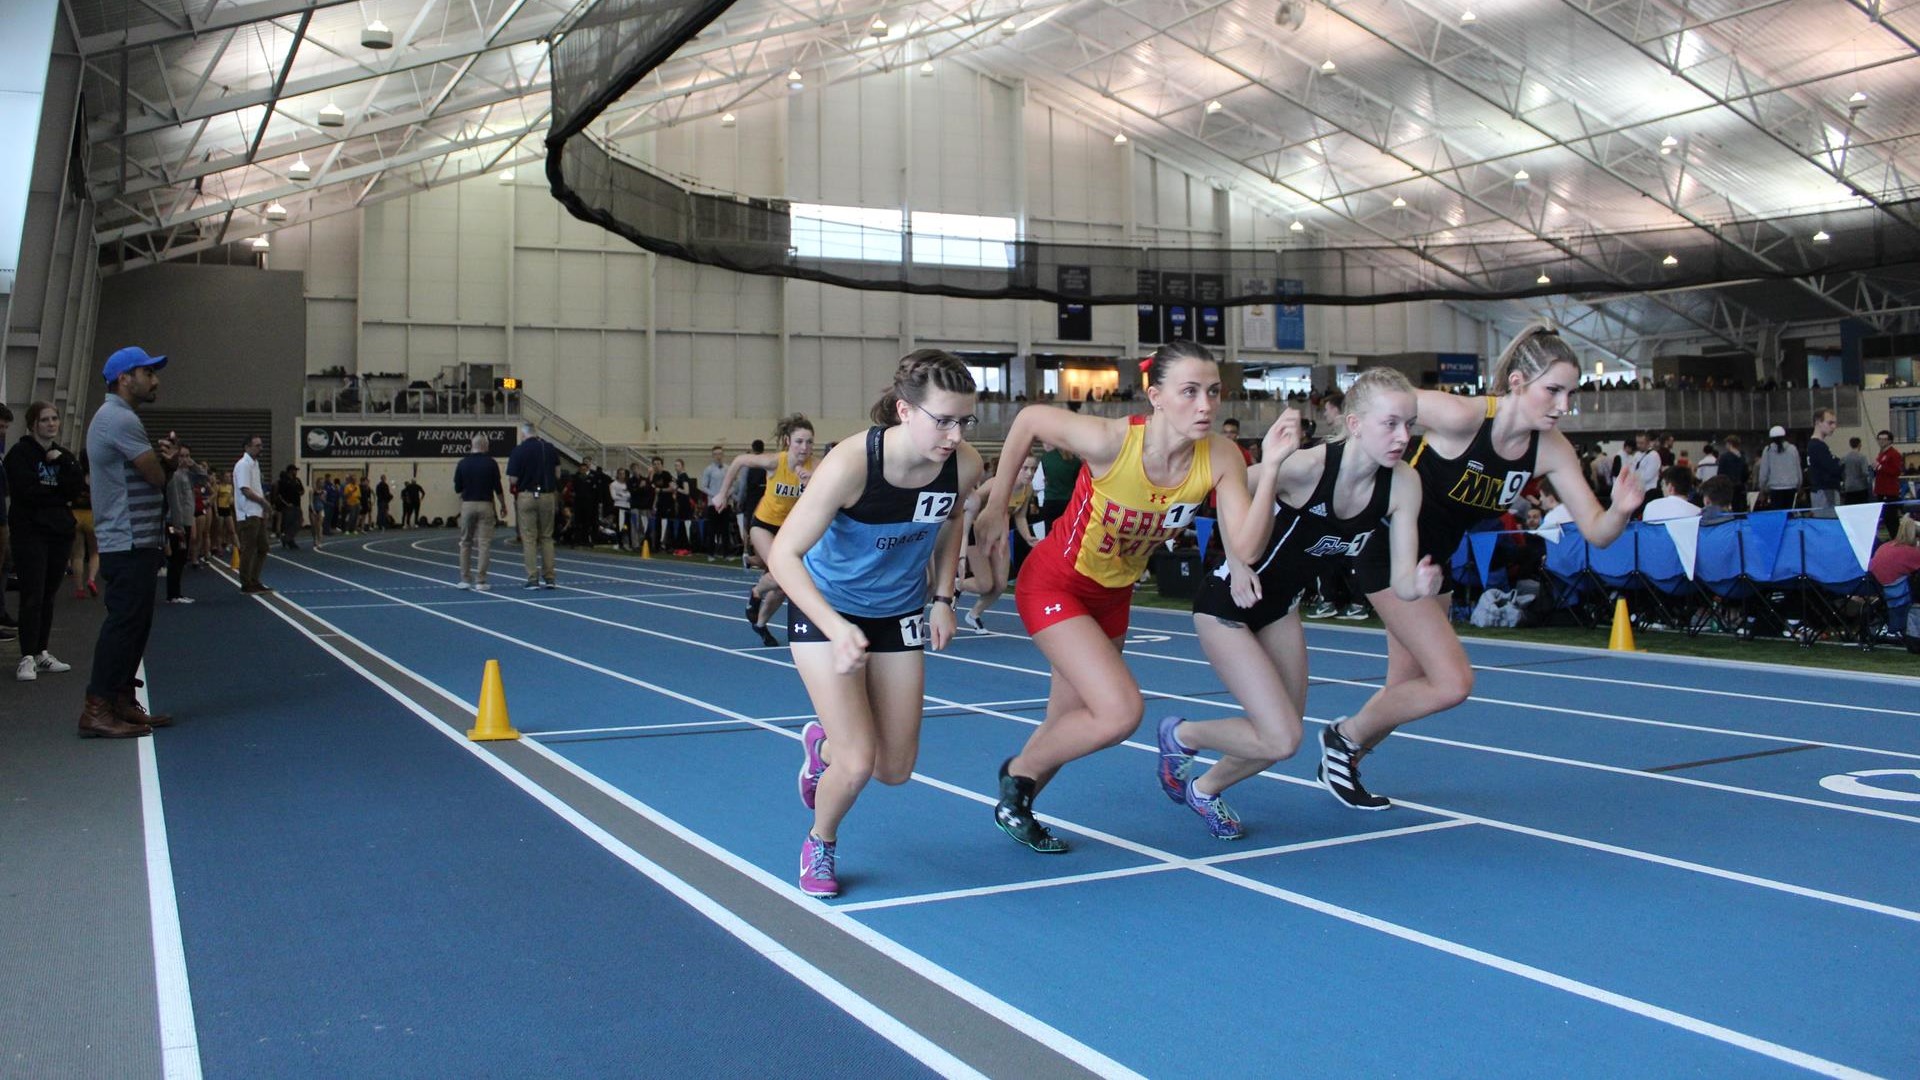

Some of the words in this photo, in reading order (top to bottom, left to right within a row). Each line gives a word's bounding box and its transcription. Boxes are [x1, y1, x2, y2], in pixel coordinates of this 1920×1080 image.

[331, 430, 403, 446] NovaCare
[441, 444, 472, 454] PERC
[1504, 473, 1523, 503] 9
[921, 495, 953, 517] 12
[1170, 504, 1201, 523] 1
[875, 530, 929, 550] GRACE
